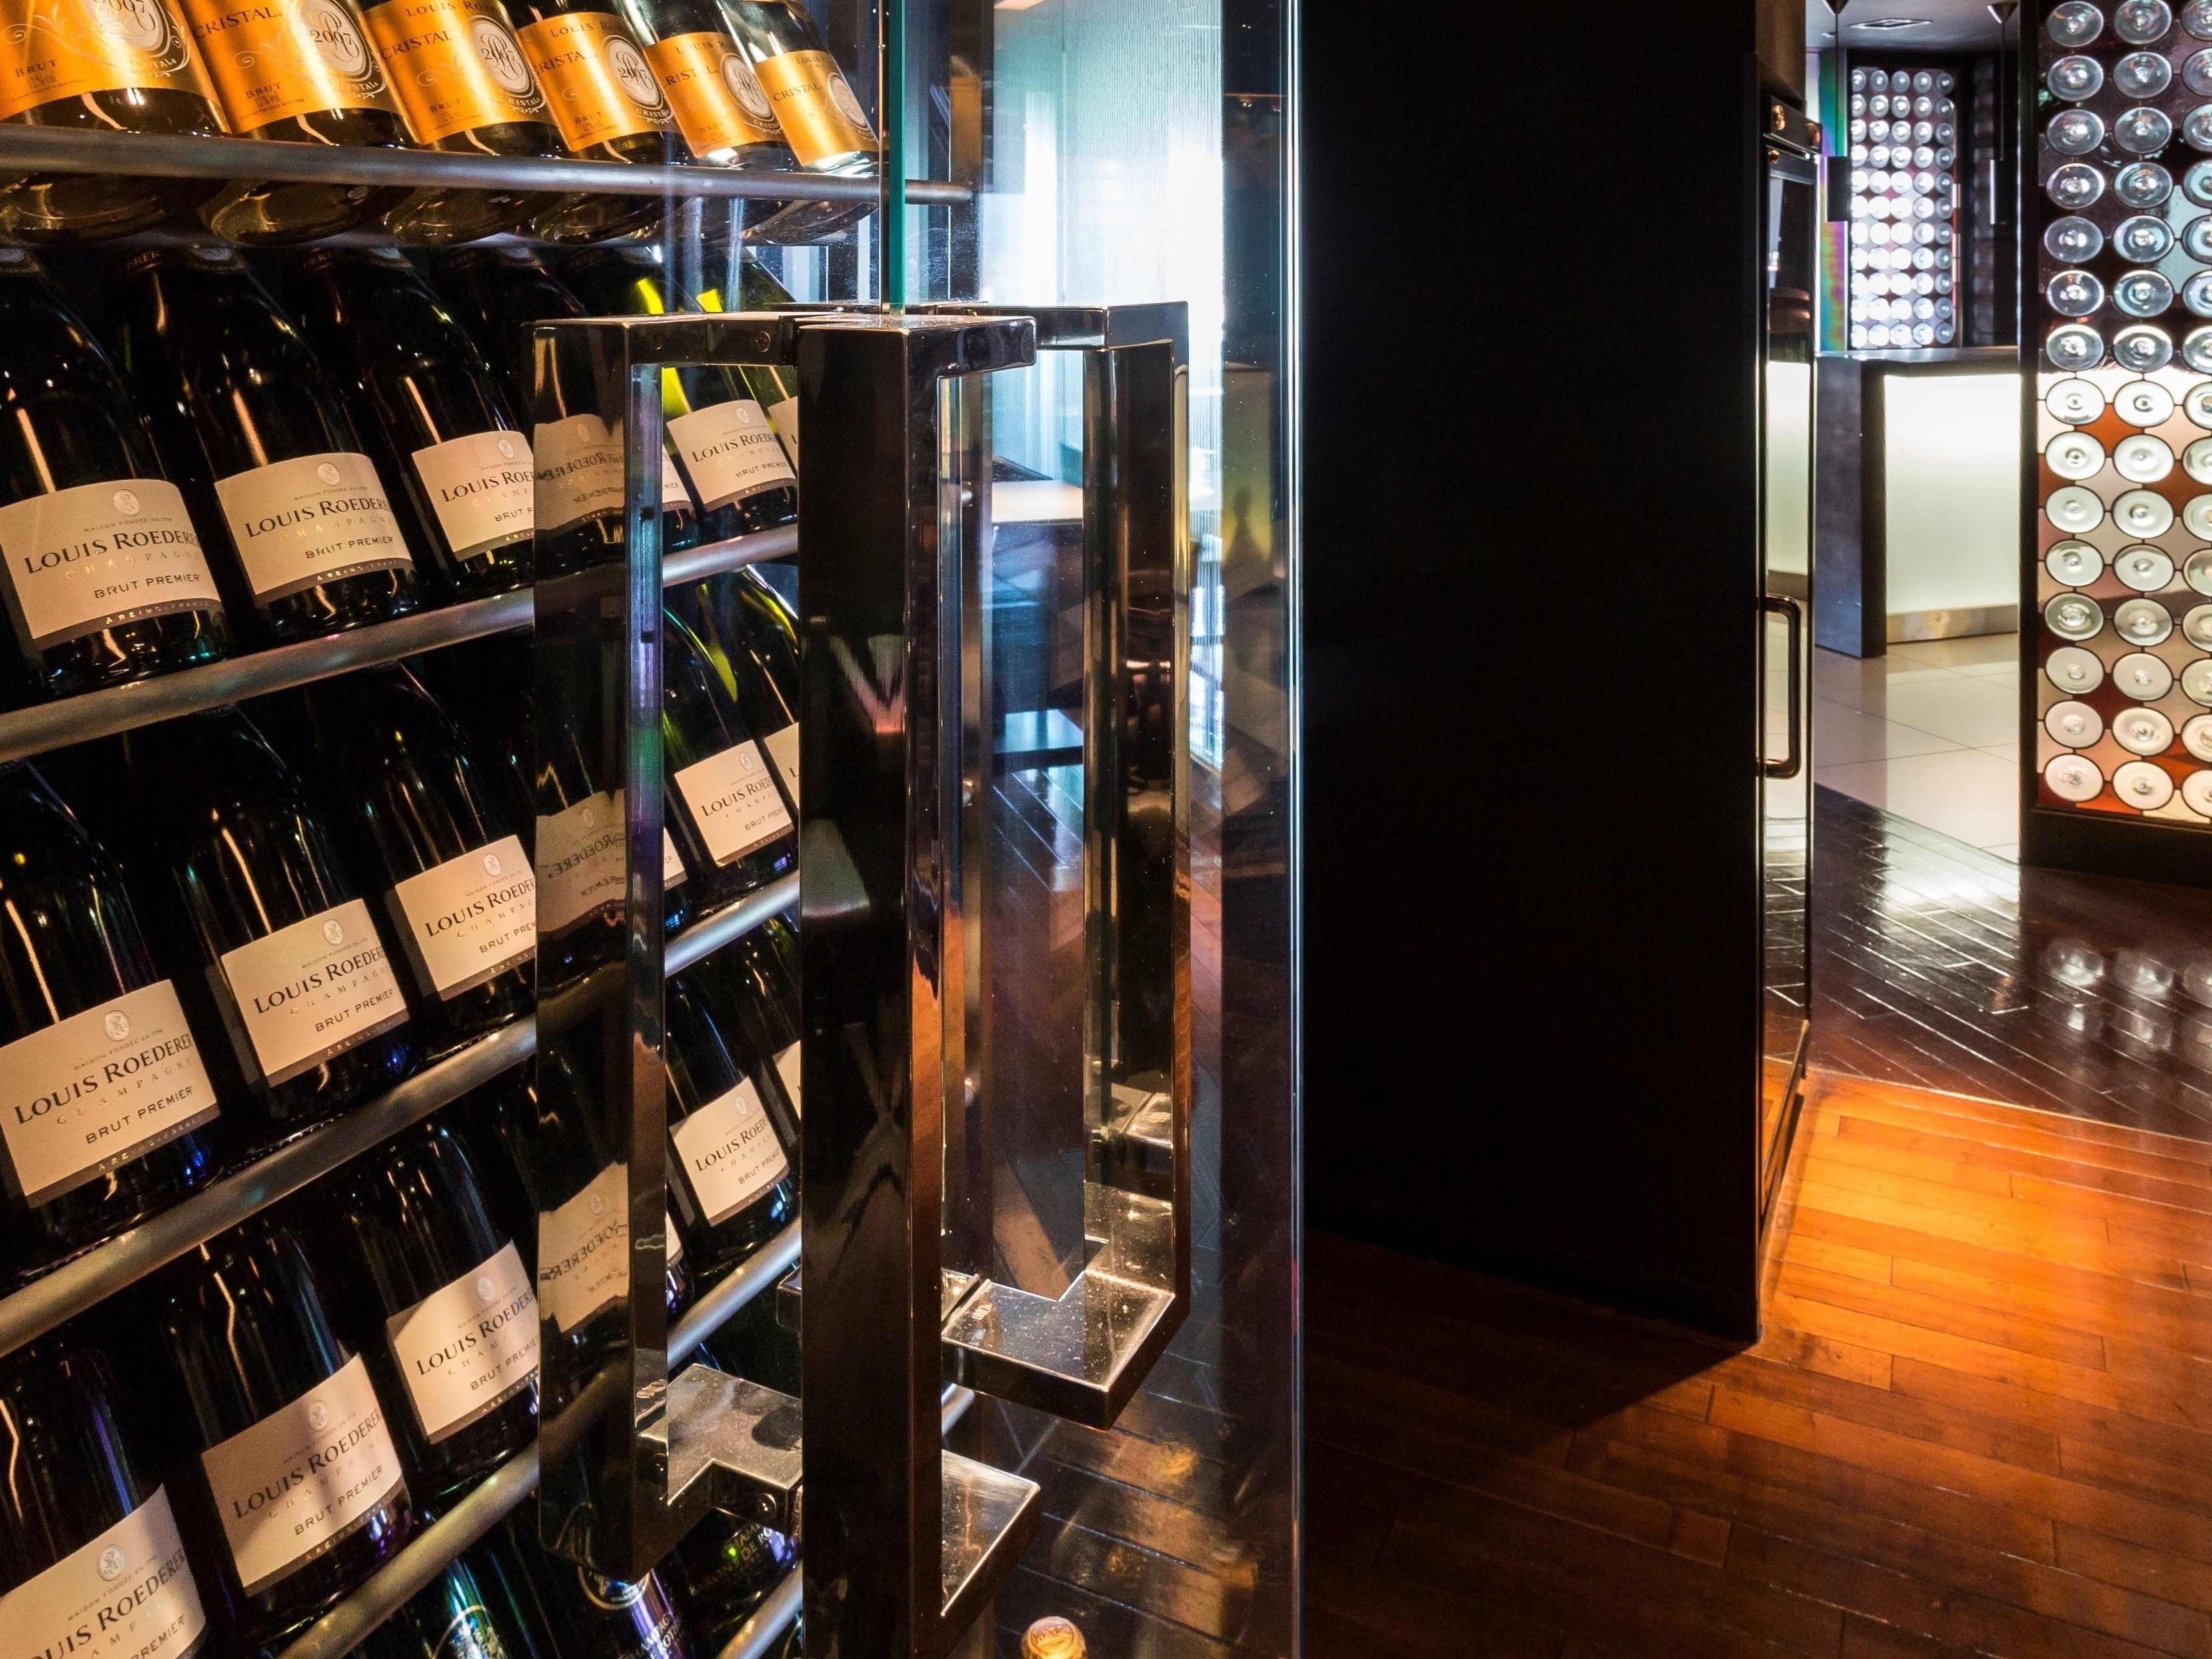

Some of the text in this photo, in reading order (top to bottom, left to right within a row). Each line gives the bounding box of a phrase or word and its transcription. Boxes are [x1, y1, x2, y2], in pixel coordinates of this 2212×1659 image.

[406, 1, 456, 17] LOUIS
[193, 7, 277, 39] CRISTAL
[381, 31, 453, 60] CRISTAL
[15, 59, 57, 77] BRUT
[245, 83, 281, 99] BRUT
[773, 83, 821, 102] CRISTAL
[430, 98, 461, 113] BRUT
[691, 439, 739, 463] LOUIS
[441, 476, 500, 503] LOUIS
[245, 507, 316, 539] LOUIS
[494, 508, 524, 523] BRUT
[23, 539, 108, 575] LOUIS
[305, 536, 395, 560] BRUT PREMIER
[93, 573, 201, 599] BRUT PREMIER
[701, 789, 746, 817] LOUIS
[744, 816, 767, 832] BRUT
[425, 900, 485, 937] LOUIS
[479, 933, 512, 954] BRUT
[253, 973, 323, 1014] LOUIS
[315, 988, 394, 1033] BRUT PREMIER
[14, 1074, 99, 1124] LOUIS
[86, 1086, 193, 1144] BRUT PREMIER
[695, 1138, 741, 1172] LOUIS
[738, 1166, 761, 1185] BRUT
[416, 1332, 477, 1376] LOUIS
[470, 1366, 504, 1391] BRUT
[233, 1466, 305, 1520] LOUIS
[295, 1504, 333, 1536] BRUT
[337, 1464, 384, 1507] PREMIER
